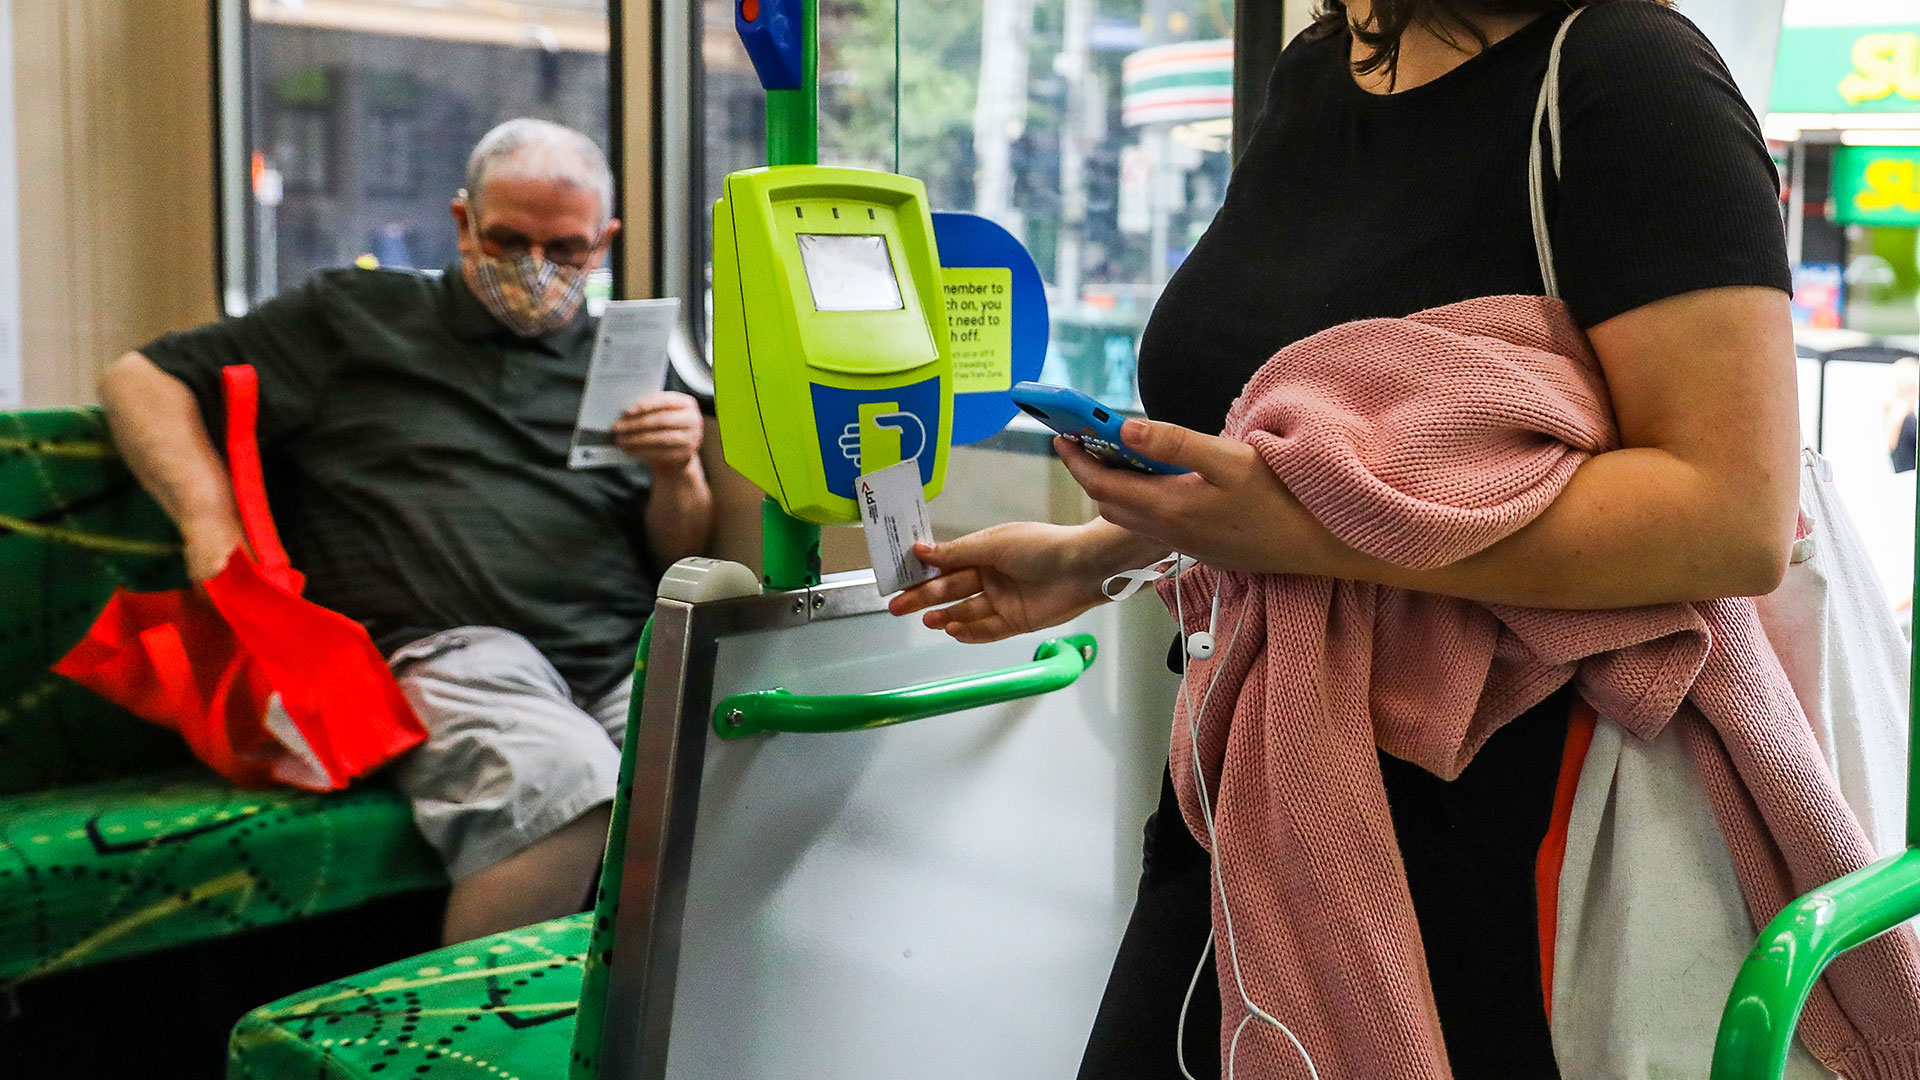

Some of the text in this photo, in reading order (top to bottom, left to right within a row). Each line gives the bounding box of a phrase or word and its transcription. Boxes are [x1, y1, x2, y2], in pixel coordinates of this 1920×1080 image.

[991, 284, 1003, 294] to
[981, 300, 1002, 314] you
[956, 314, 985, 326] need
[988, 315, 1000, 326] to
